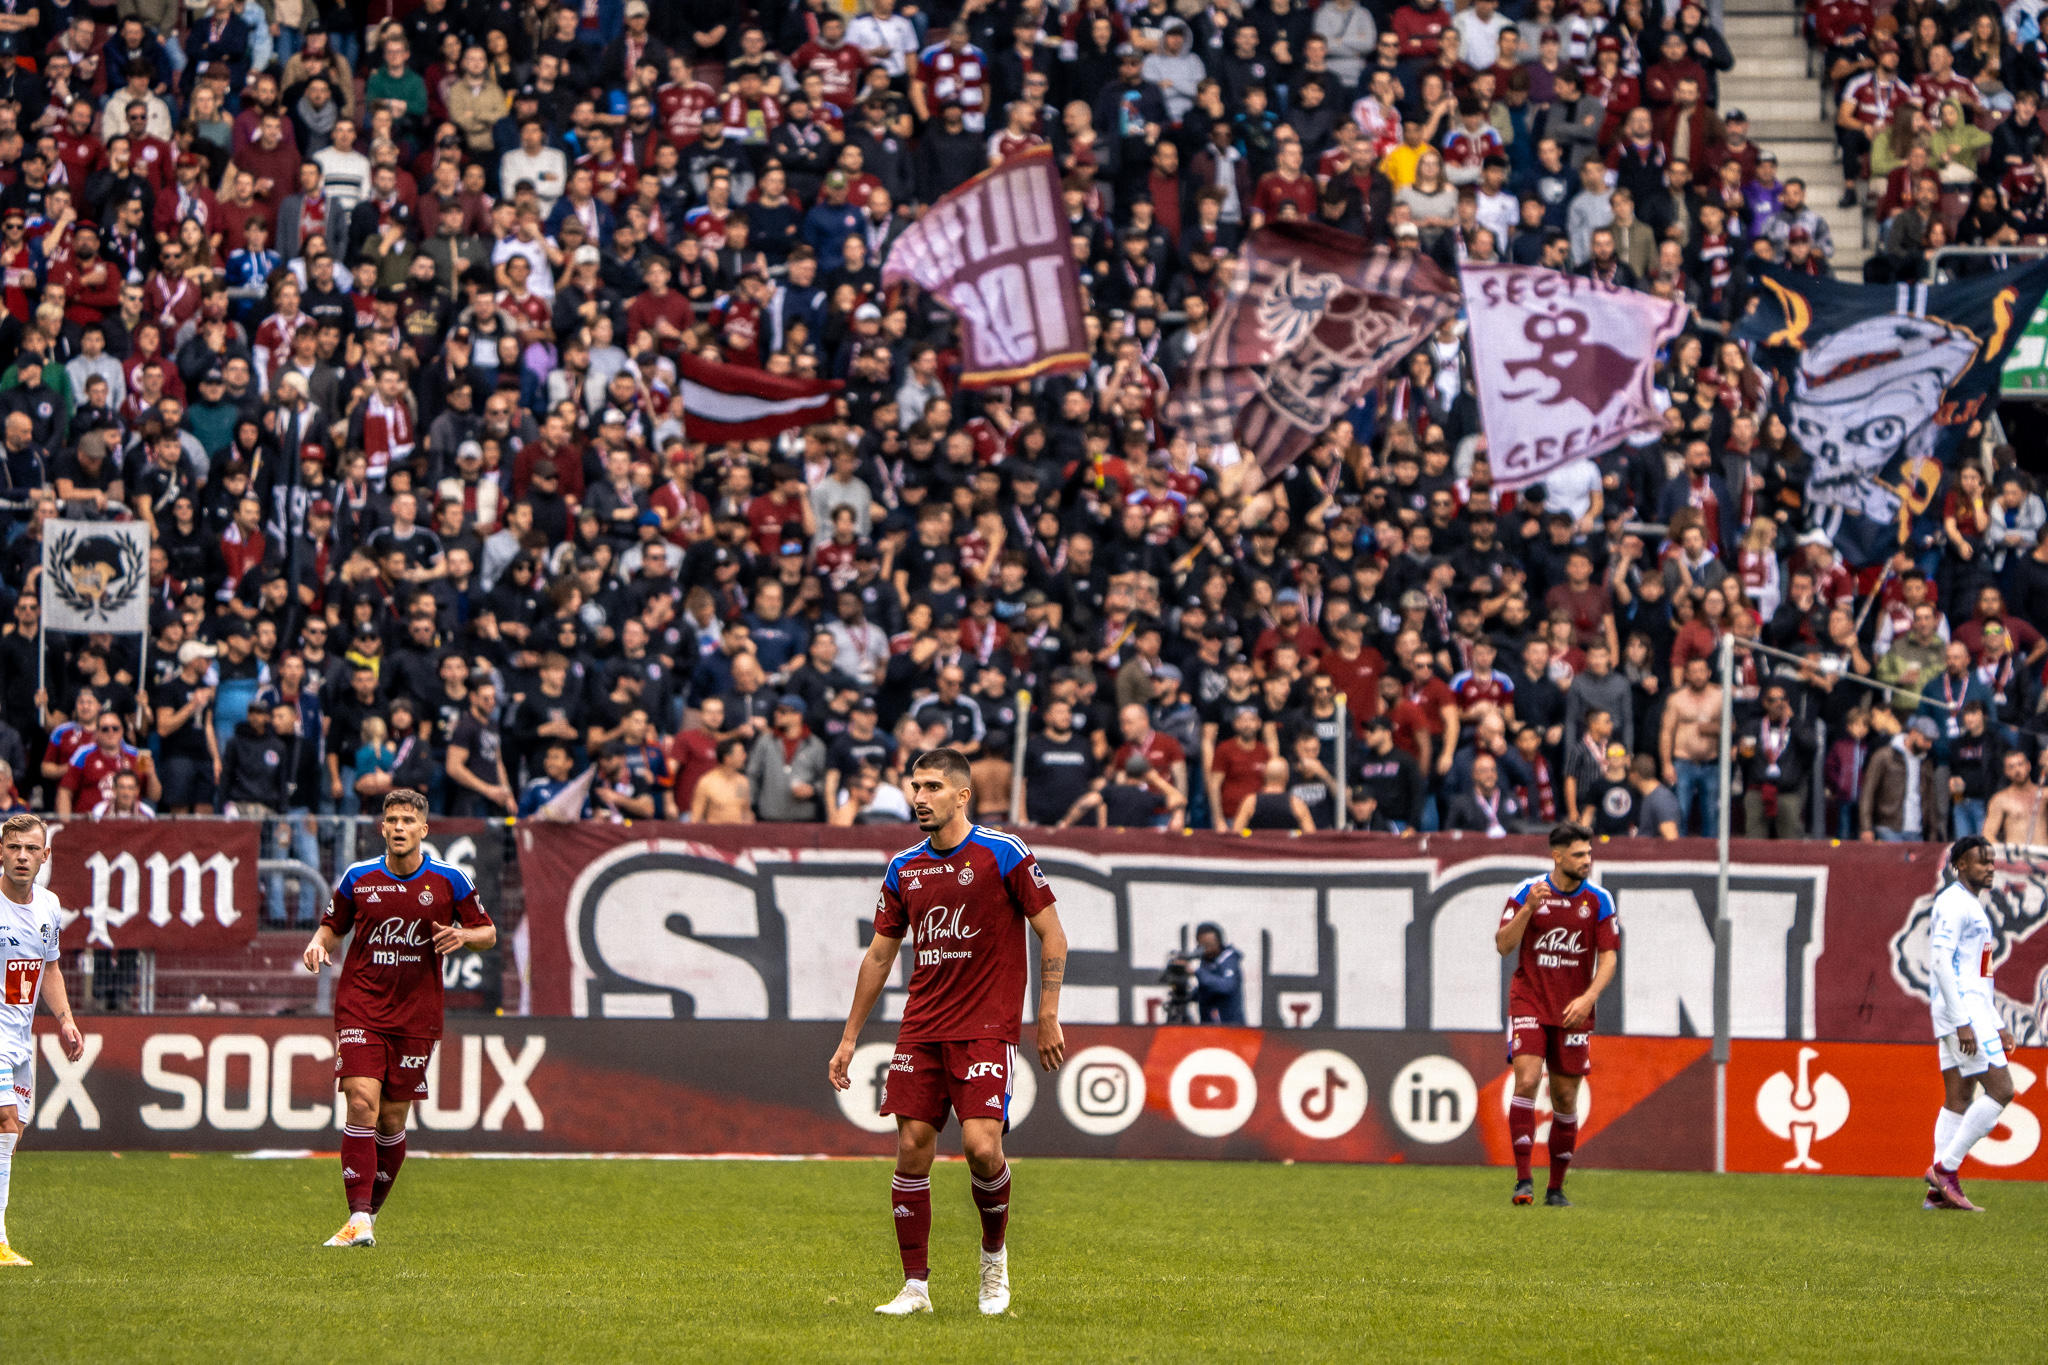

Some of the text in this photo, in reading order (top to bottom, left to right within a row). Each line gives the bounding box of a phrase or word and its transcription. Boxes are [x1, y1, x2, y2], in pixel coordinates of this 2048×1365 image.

[922, 866, 944, 876] SUISSE
[373, 950, 395, 965] m3
[919, 949, 972, 965] m3 GROUPE
[8, 960, 41, 971] OTTO'S
[964, 1062, 1003, 1080] KFC
[140, 1034, 547, 1131] SOCUX
